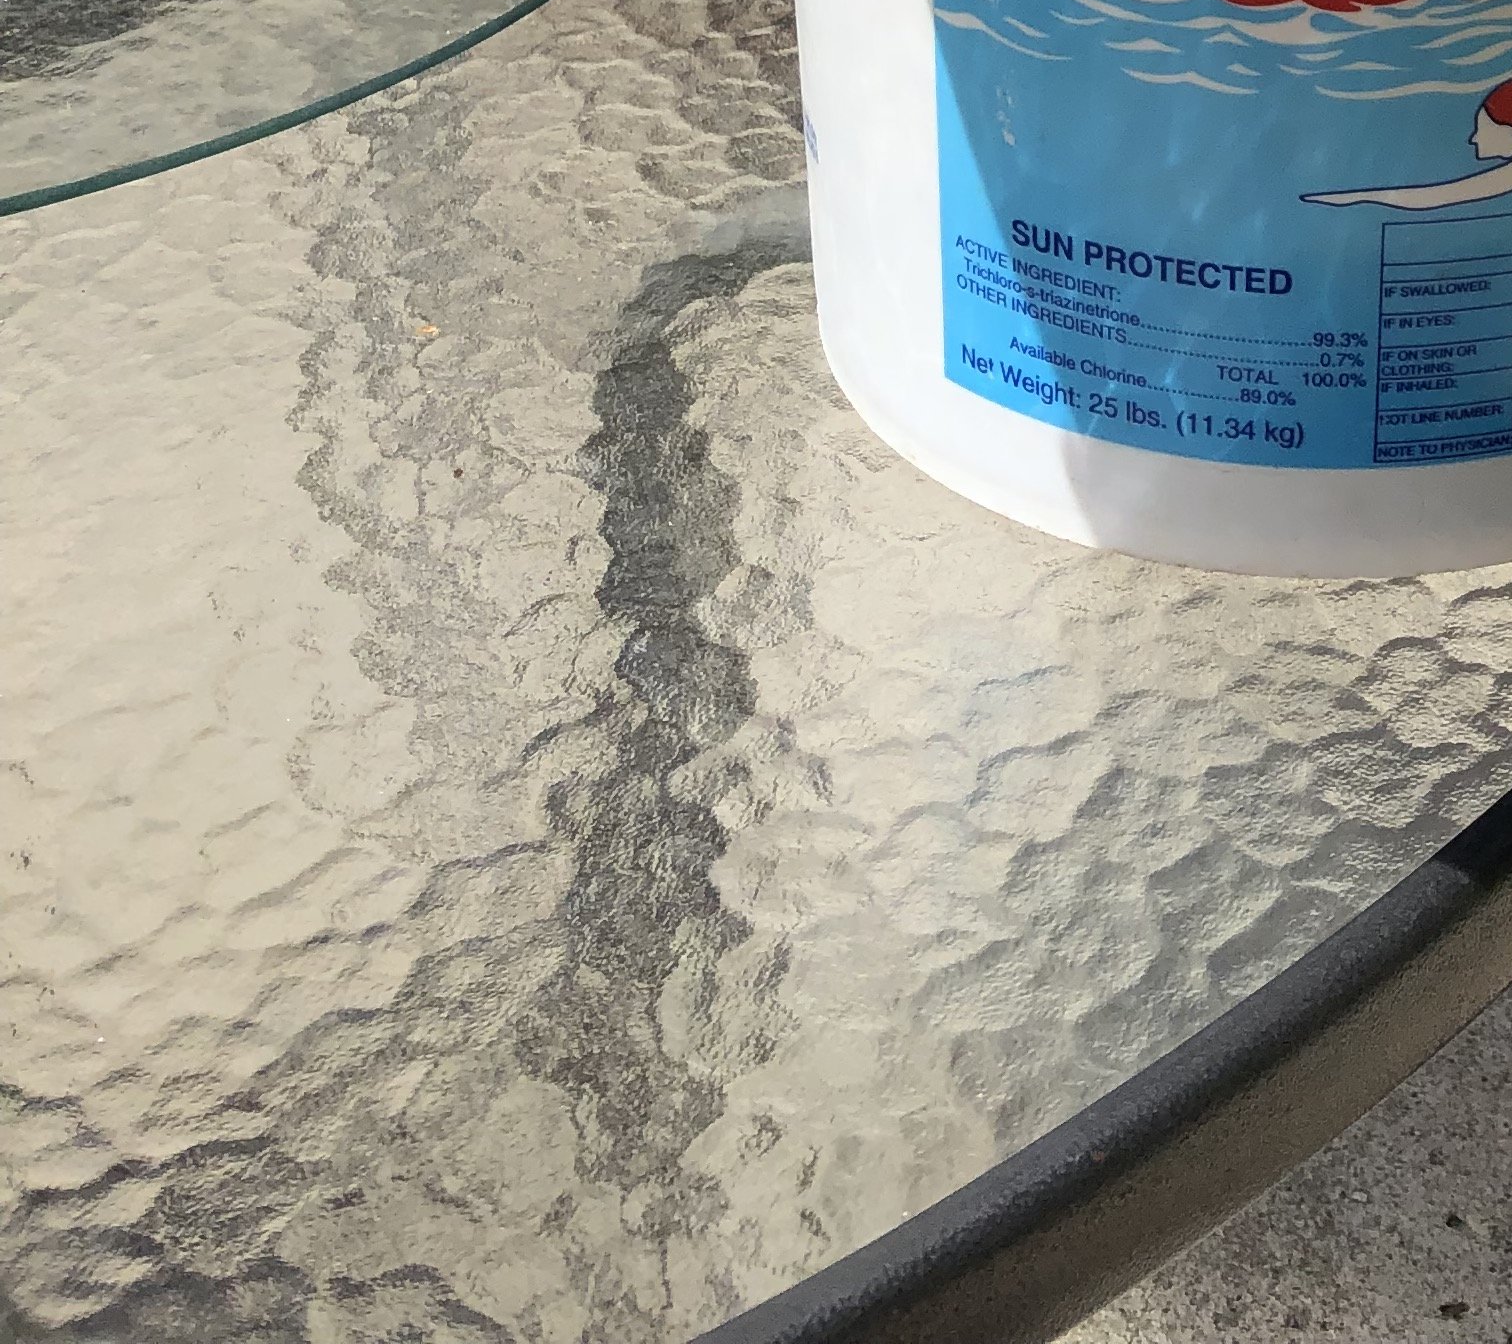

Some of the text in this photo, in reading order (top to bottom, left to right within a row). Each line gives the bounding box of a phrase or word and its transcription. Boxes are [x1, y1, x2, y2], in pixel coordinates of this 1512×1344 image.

[1011, 218, 1294, 296] SUN PROTECTED
[955, 234, 1121, 303] ACTIVE INGREDIENT:
[1384, 279, 1492, 298] IF SWALLOWED:
[955, 273, 1366, 369] OTHER INGREDIENTS 0.7%
[1383, 314, 1455, 329] IF IN EYES:
[1312, 331, 1369, 349] 99.3%
[1381, 344, 1478, 363] IF ON SKIN OR
[1009, 335, 1297, 407] Available Chlorine 89.0%
[1216, 364, 1368, 389] TOTAL 100.0%
[1380, 362, 1455, 377] CLOTHING:
[1380, 377, 1459, 393] IF INHALED:
[961, 343, 1305, 450] Net Weight: 25 lbs. (11.34 kg)
[1377, 444, 1416, 458] NOTE
[1418, 443, 1439, 455] TO
